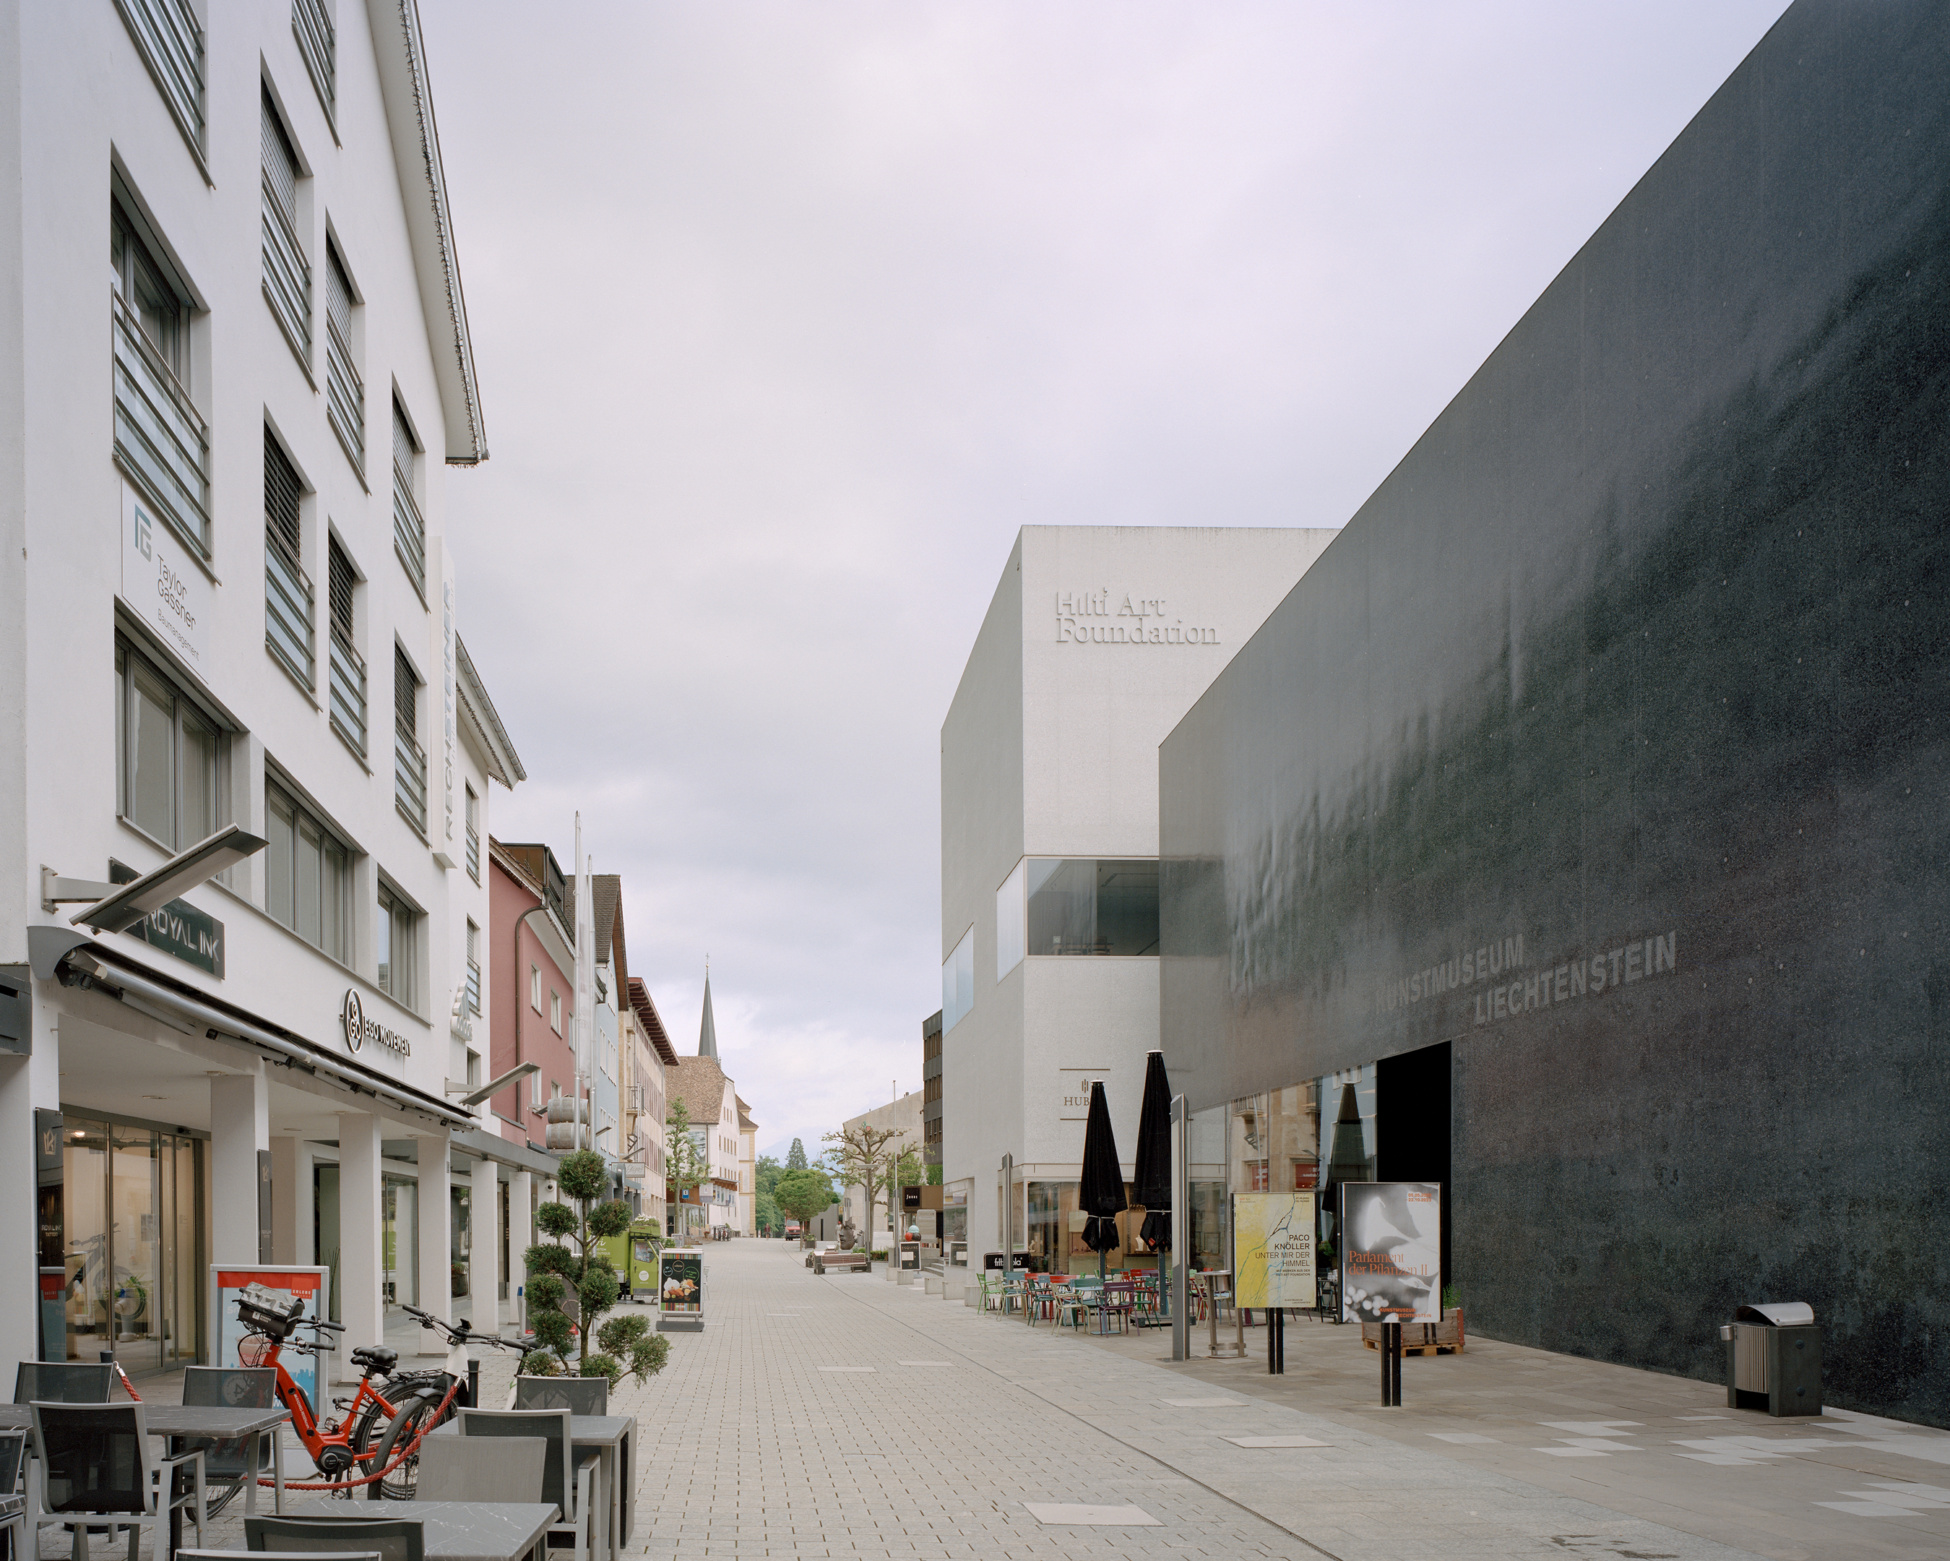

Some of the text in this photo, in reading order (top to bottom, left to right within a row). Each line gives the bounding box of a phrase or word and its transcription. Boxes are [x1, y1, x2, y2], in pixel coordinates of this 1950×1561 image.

[157, 553, 188, 600] Taylor
[157, 578, 196, 631] Gassner
[1056, 587, 1166, 616] Hilti Art
[157, 608, 200, 662] Baumanagement
[1056, 617, 1221, 645] Foundation
[200, 929, 219, 962] INK
[1376, 933, 1524, 1014] KUNSTMUSEUM
[1475, 930, 1678, 1025] LIECHTENSTEIN
[364, 1017, 380, 1041] EGO
[1064, 1096, 1090, 1106] HUB
[1274, 1242, 1310, 1250] KNÖLLER
[1349, 1250, 1404, 1263] Parlament
[1348, 1263, 1428, 1276] der Pflanzen II
